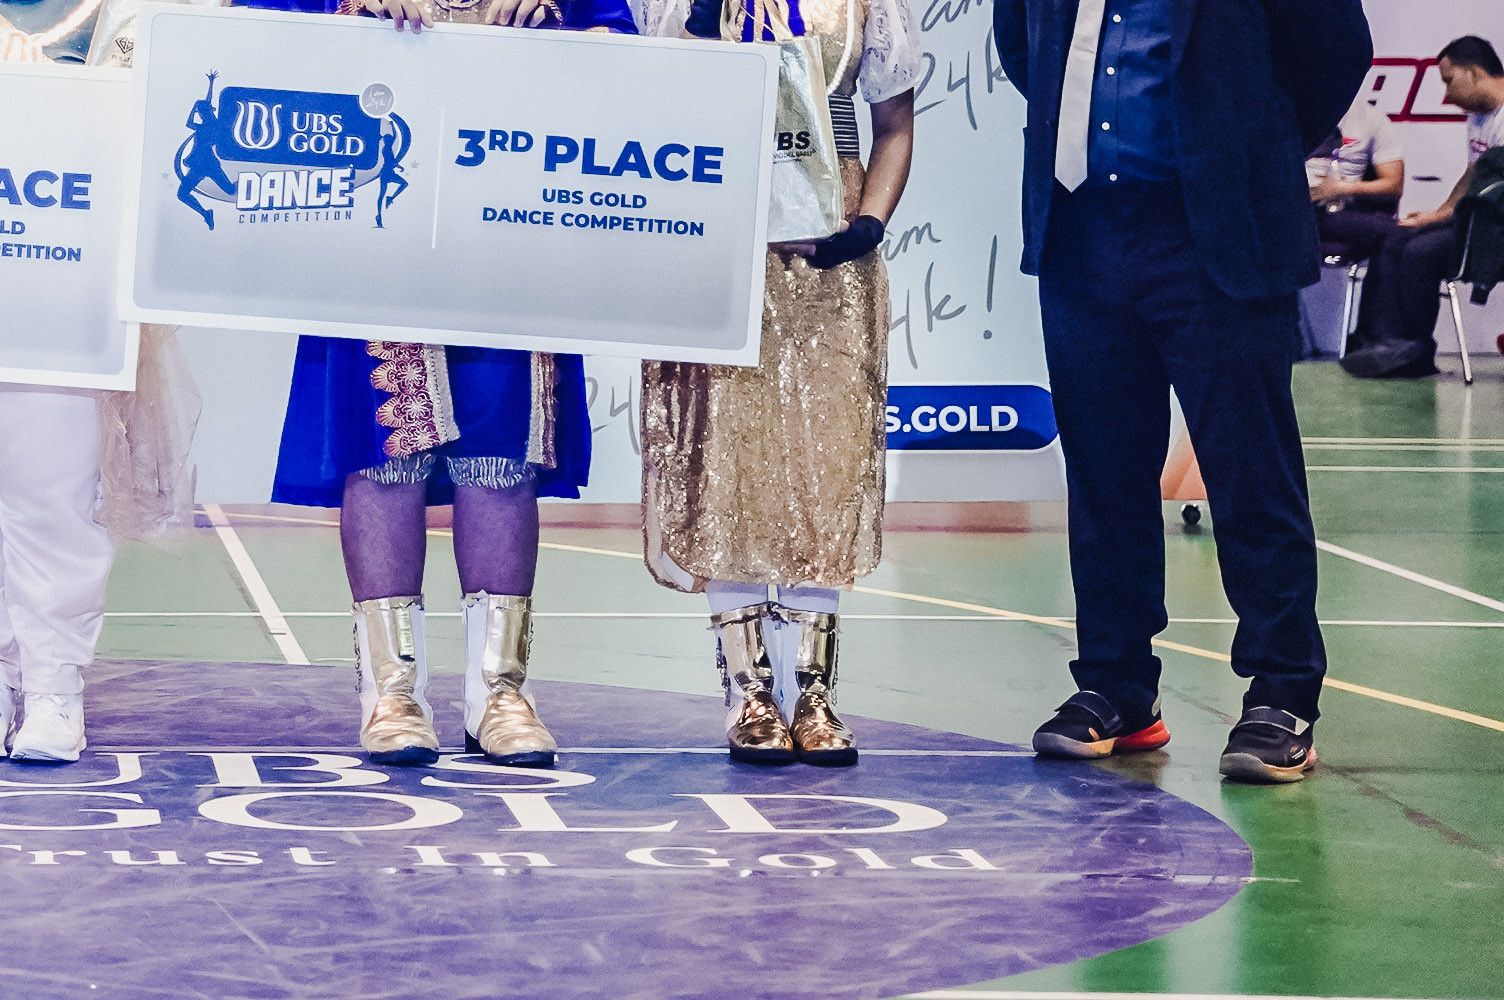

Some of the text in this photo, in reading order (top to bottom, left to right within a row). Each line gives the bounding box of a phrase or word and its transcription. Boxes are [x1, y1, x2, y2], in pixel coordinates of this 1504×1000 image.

[292, 111, 343, 134] UBS
[289, 132, 364, 156] GOLD
[773, 131, 810, 151] BS
[454, 128, 724, 184] 3RD PLACE
[236, 168, 355, 211] DANCE
[542, 188, 647, 209] UBS GOLD
[238, 210, 353, 224] COMPETITION
[482, 207, 704, 237] DANCE COMPETITION
[886, 404, 1018, 433] S.GOLD
[404, 845, 560, 867] In
[625, 846, 1004, 871] Gold
